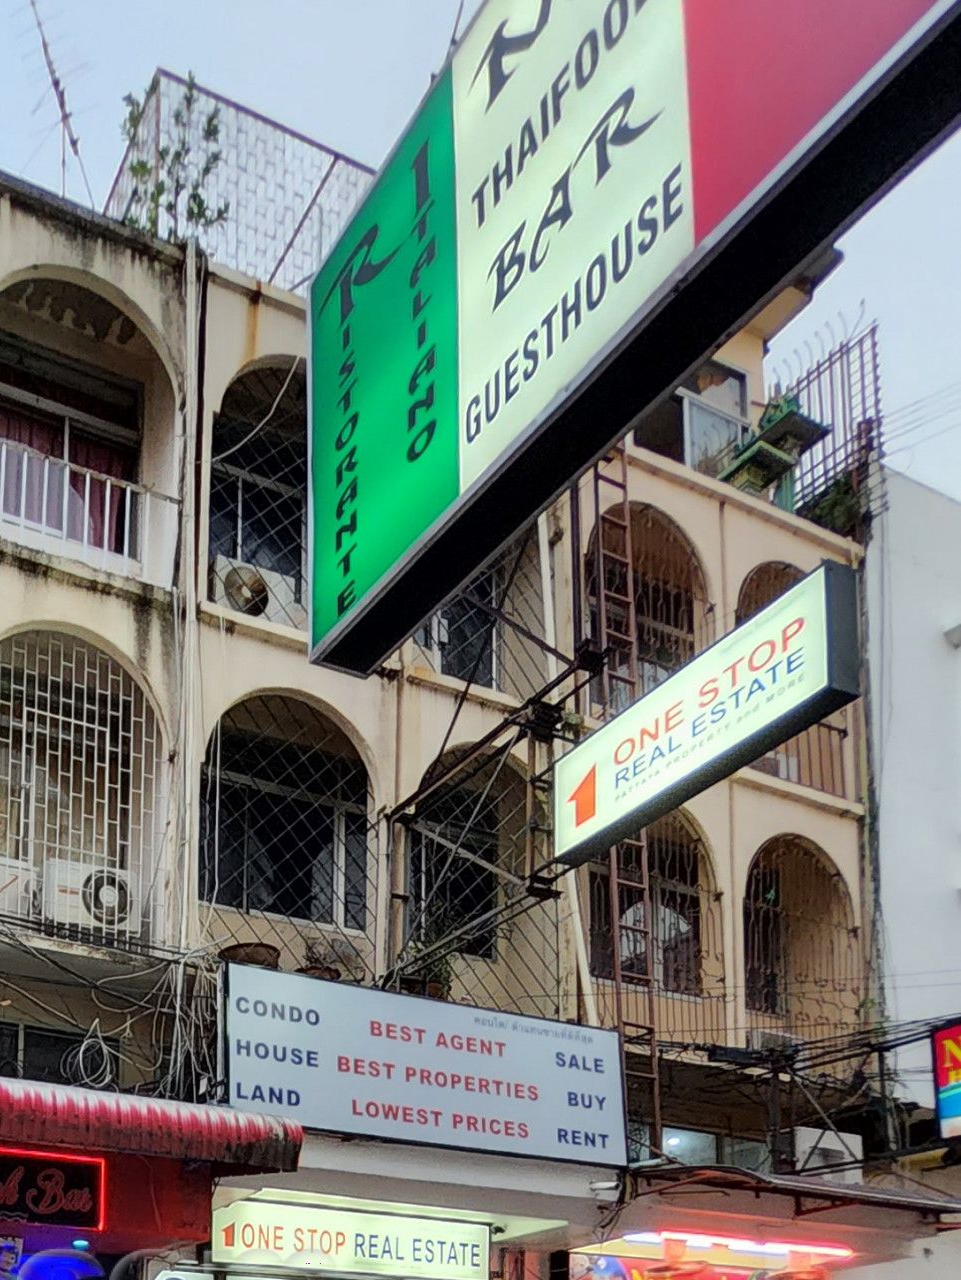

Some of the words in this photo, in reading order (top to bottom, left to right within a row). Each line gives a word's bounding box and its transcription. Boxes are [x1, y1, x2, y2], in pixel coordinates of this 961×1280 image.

[472, 0, 648, 229] THAIFOO
[486, 86, 666, 314] BAR
[464, 161, 685, 445] GUESTHOUSE
[317, 222, 403, 617] RISTORANTE
[612, 698, 685, 766] ONE
[697, 616, 807, 710] STOP
[613, 735, 683, 790] REAL
[690, 646, 806, 739] ESTATE
[235, 996, 321, 1027] CONDO
[236, 1038, 320, 1068] HOUSE
[369, 1020, 427, 1045] BEST
[436, 1032, 507, 1058] AGENT
[337, 1055, 396, 1081] BEST
[405, 1066, 540, 1101] PROPERTIES
[555, 1051, 605, 1074] SALE
[236, 1081, 302, 1107] LAND
[567, 1091, 607, 1112] BUY
[351, 1099, 444, 1129] LOWEST
[451, 1114, 530, 1139] PRICES
[556, 1127, 610, 1150] RENT
[26, 1167, 94, 1215] Bar
[241, 1223, 285, 1251] ONE
[293, 1227, 346, 1256] STOP
[354, 1232, 405, 1261] REAL
[412, 1238, 481, 1268] ESTATE
